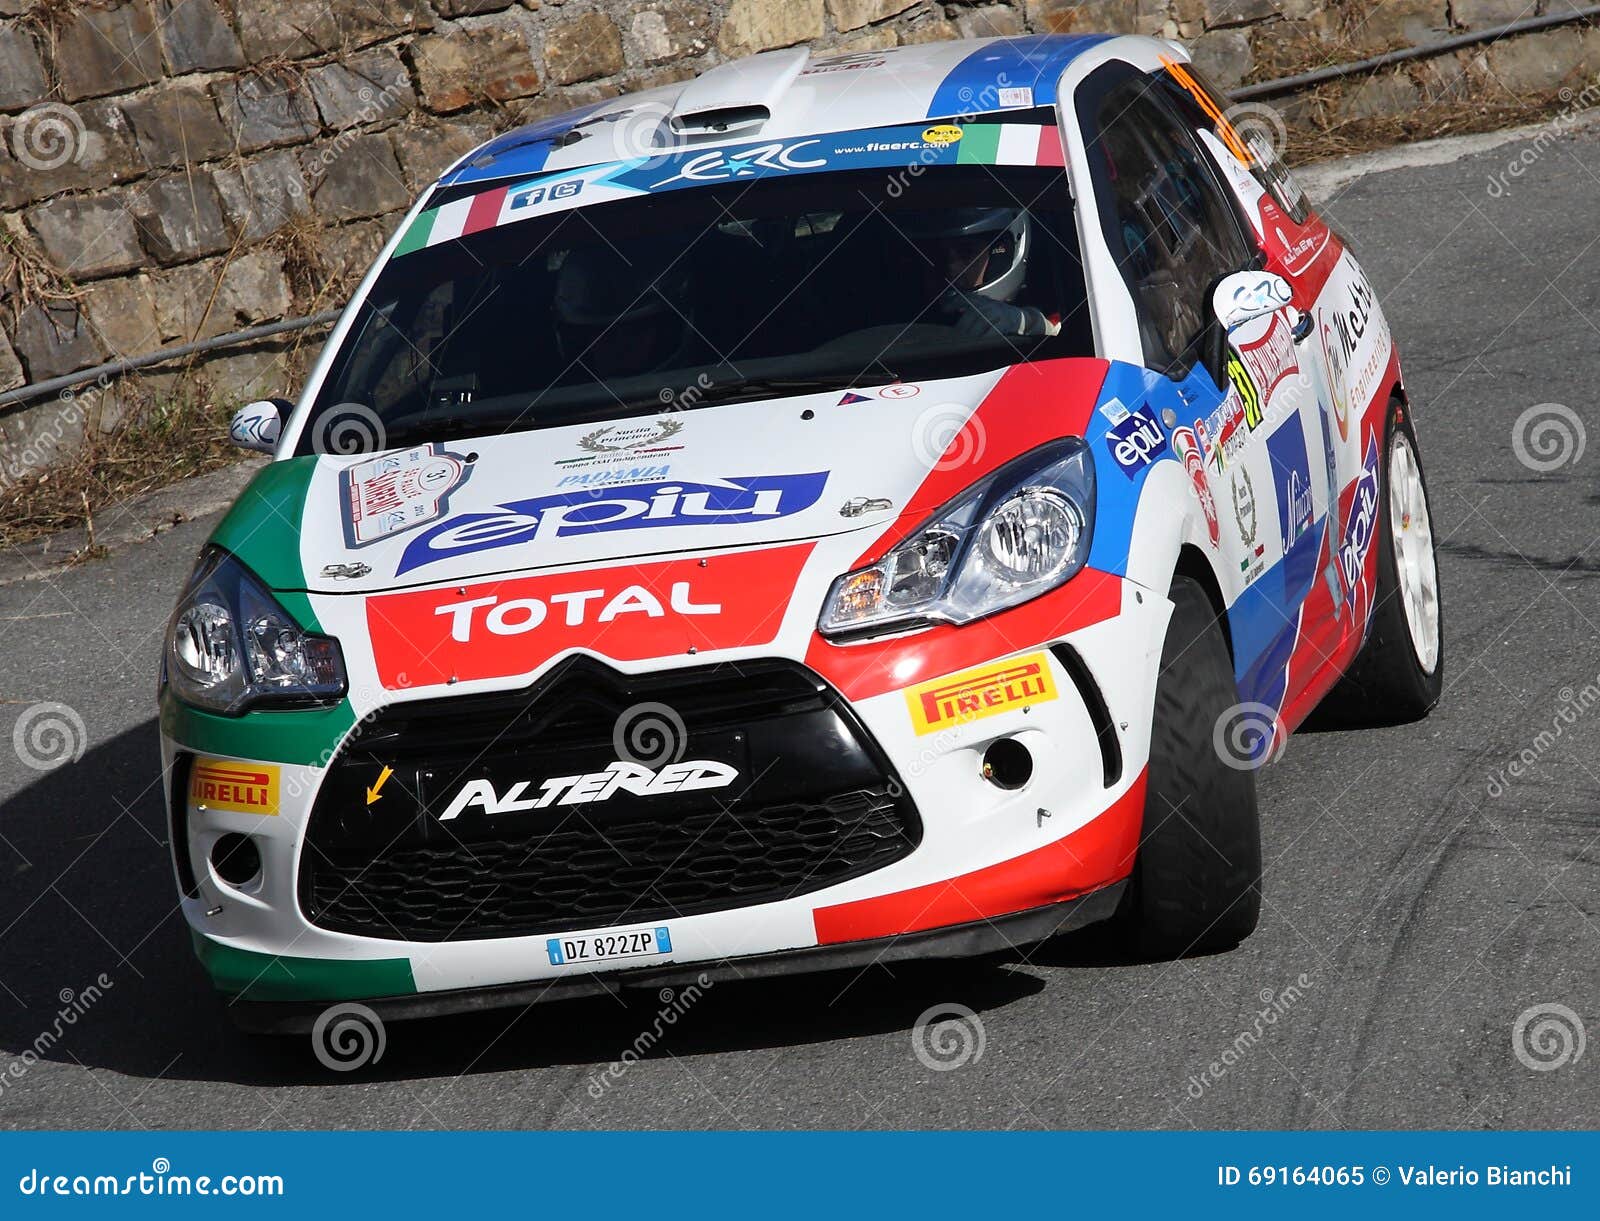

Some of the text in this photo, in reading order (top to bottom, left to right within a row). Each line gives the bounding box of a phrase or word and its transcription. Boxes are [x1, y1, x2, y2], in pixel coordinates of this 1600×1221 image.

[556, 465, 671, 487] PADANIA
[434, 580, 722, 644] TOTAL
[919, 661, 1047, 724] PIRELLI
[438, 760, 740, 821] ALTERED
[564, 940, 589, 960] DZ
[594, 933, 652, 957] 822ZP
